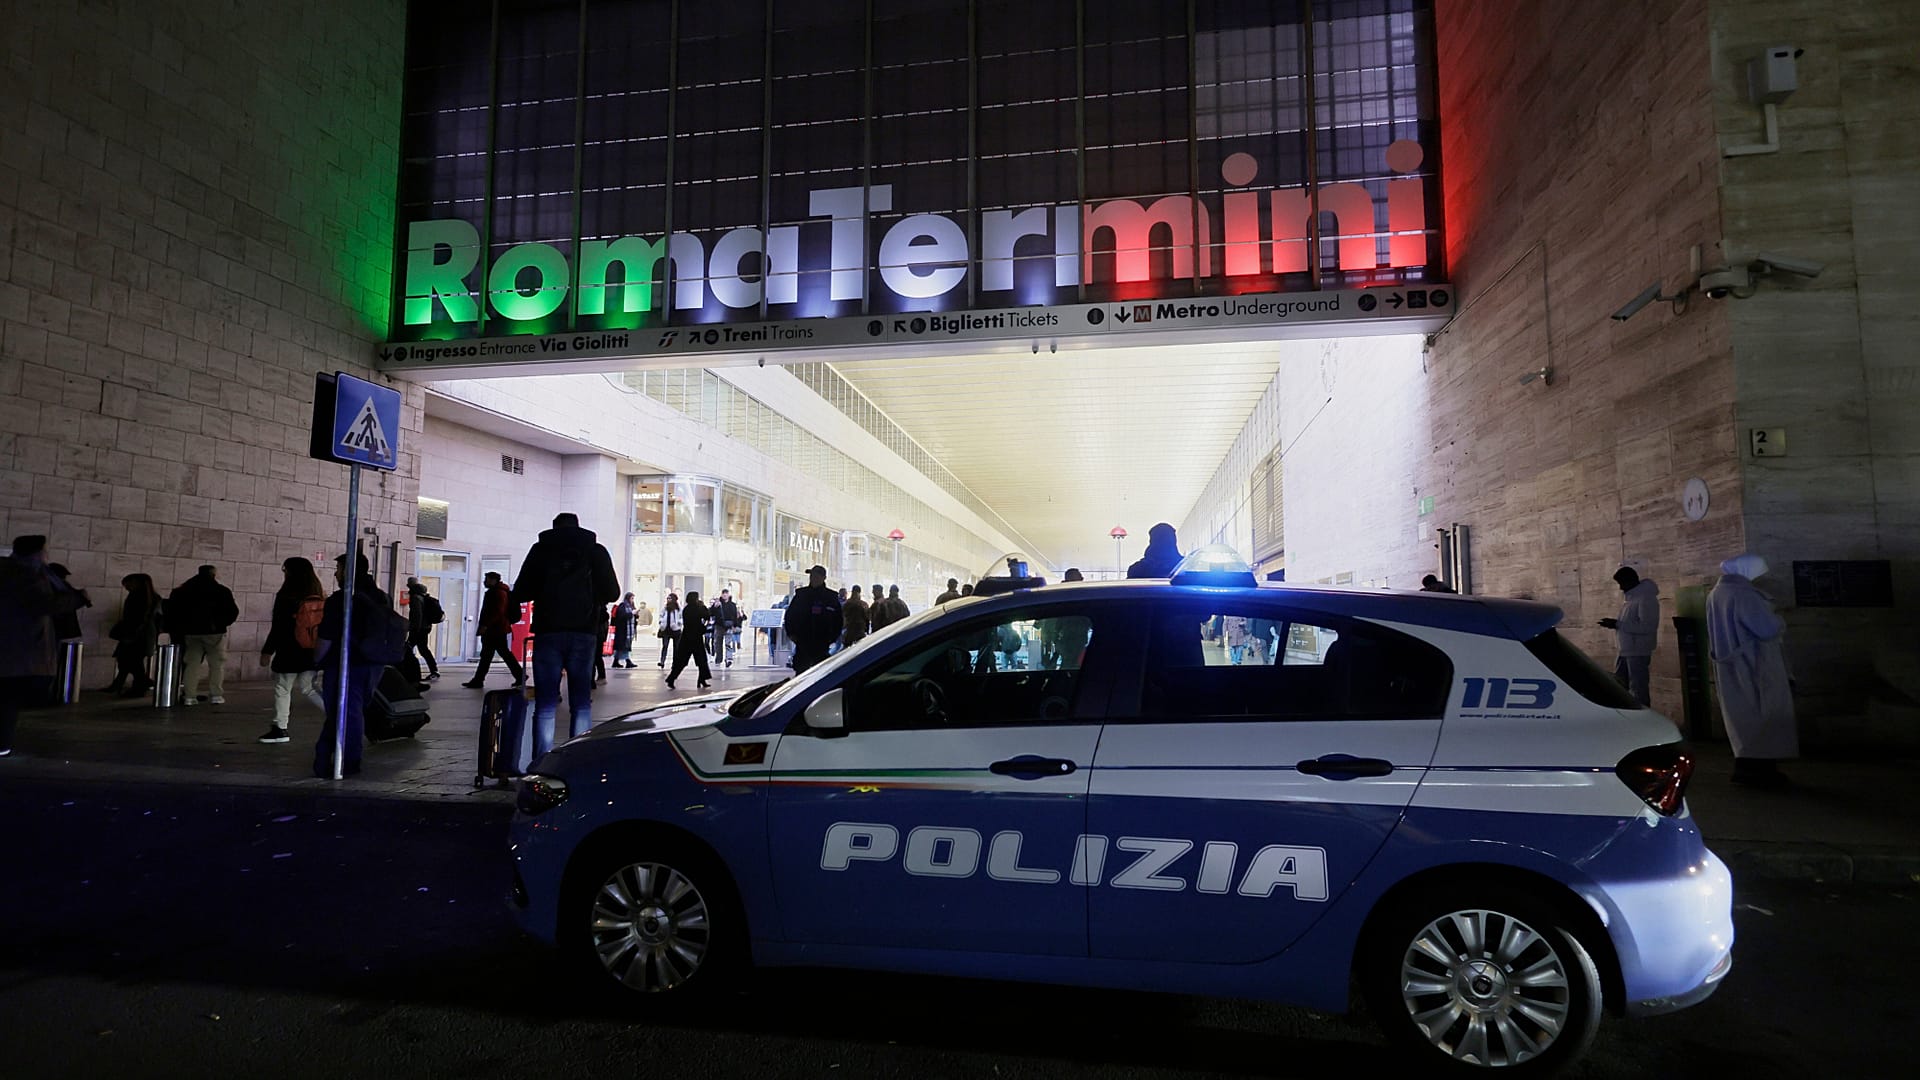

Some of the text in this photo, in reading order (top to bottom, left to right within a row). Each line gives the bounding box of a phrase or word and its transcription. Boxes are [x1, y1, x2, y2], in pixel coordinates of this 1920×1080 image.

[1156, 303, 1220, 320] Metro
[1223, 294, 1340, 317] Underground
[723, 325, 813, 342] Treni Trains
[930, 311, 1059, 334] Biglietti Tickets
[410, 334, 629, 362] Ingresso Entrance Via Giolitti
[1756, 431, 1767, 443] 2
[790, 531, 825, 554] EATALY
[1461, 677, 1557, 709] 113
[820, 821, 1329, 902] POLIZIA
